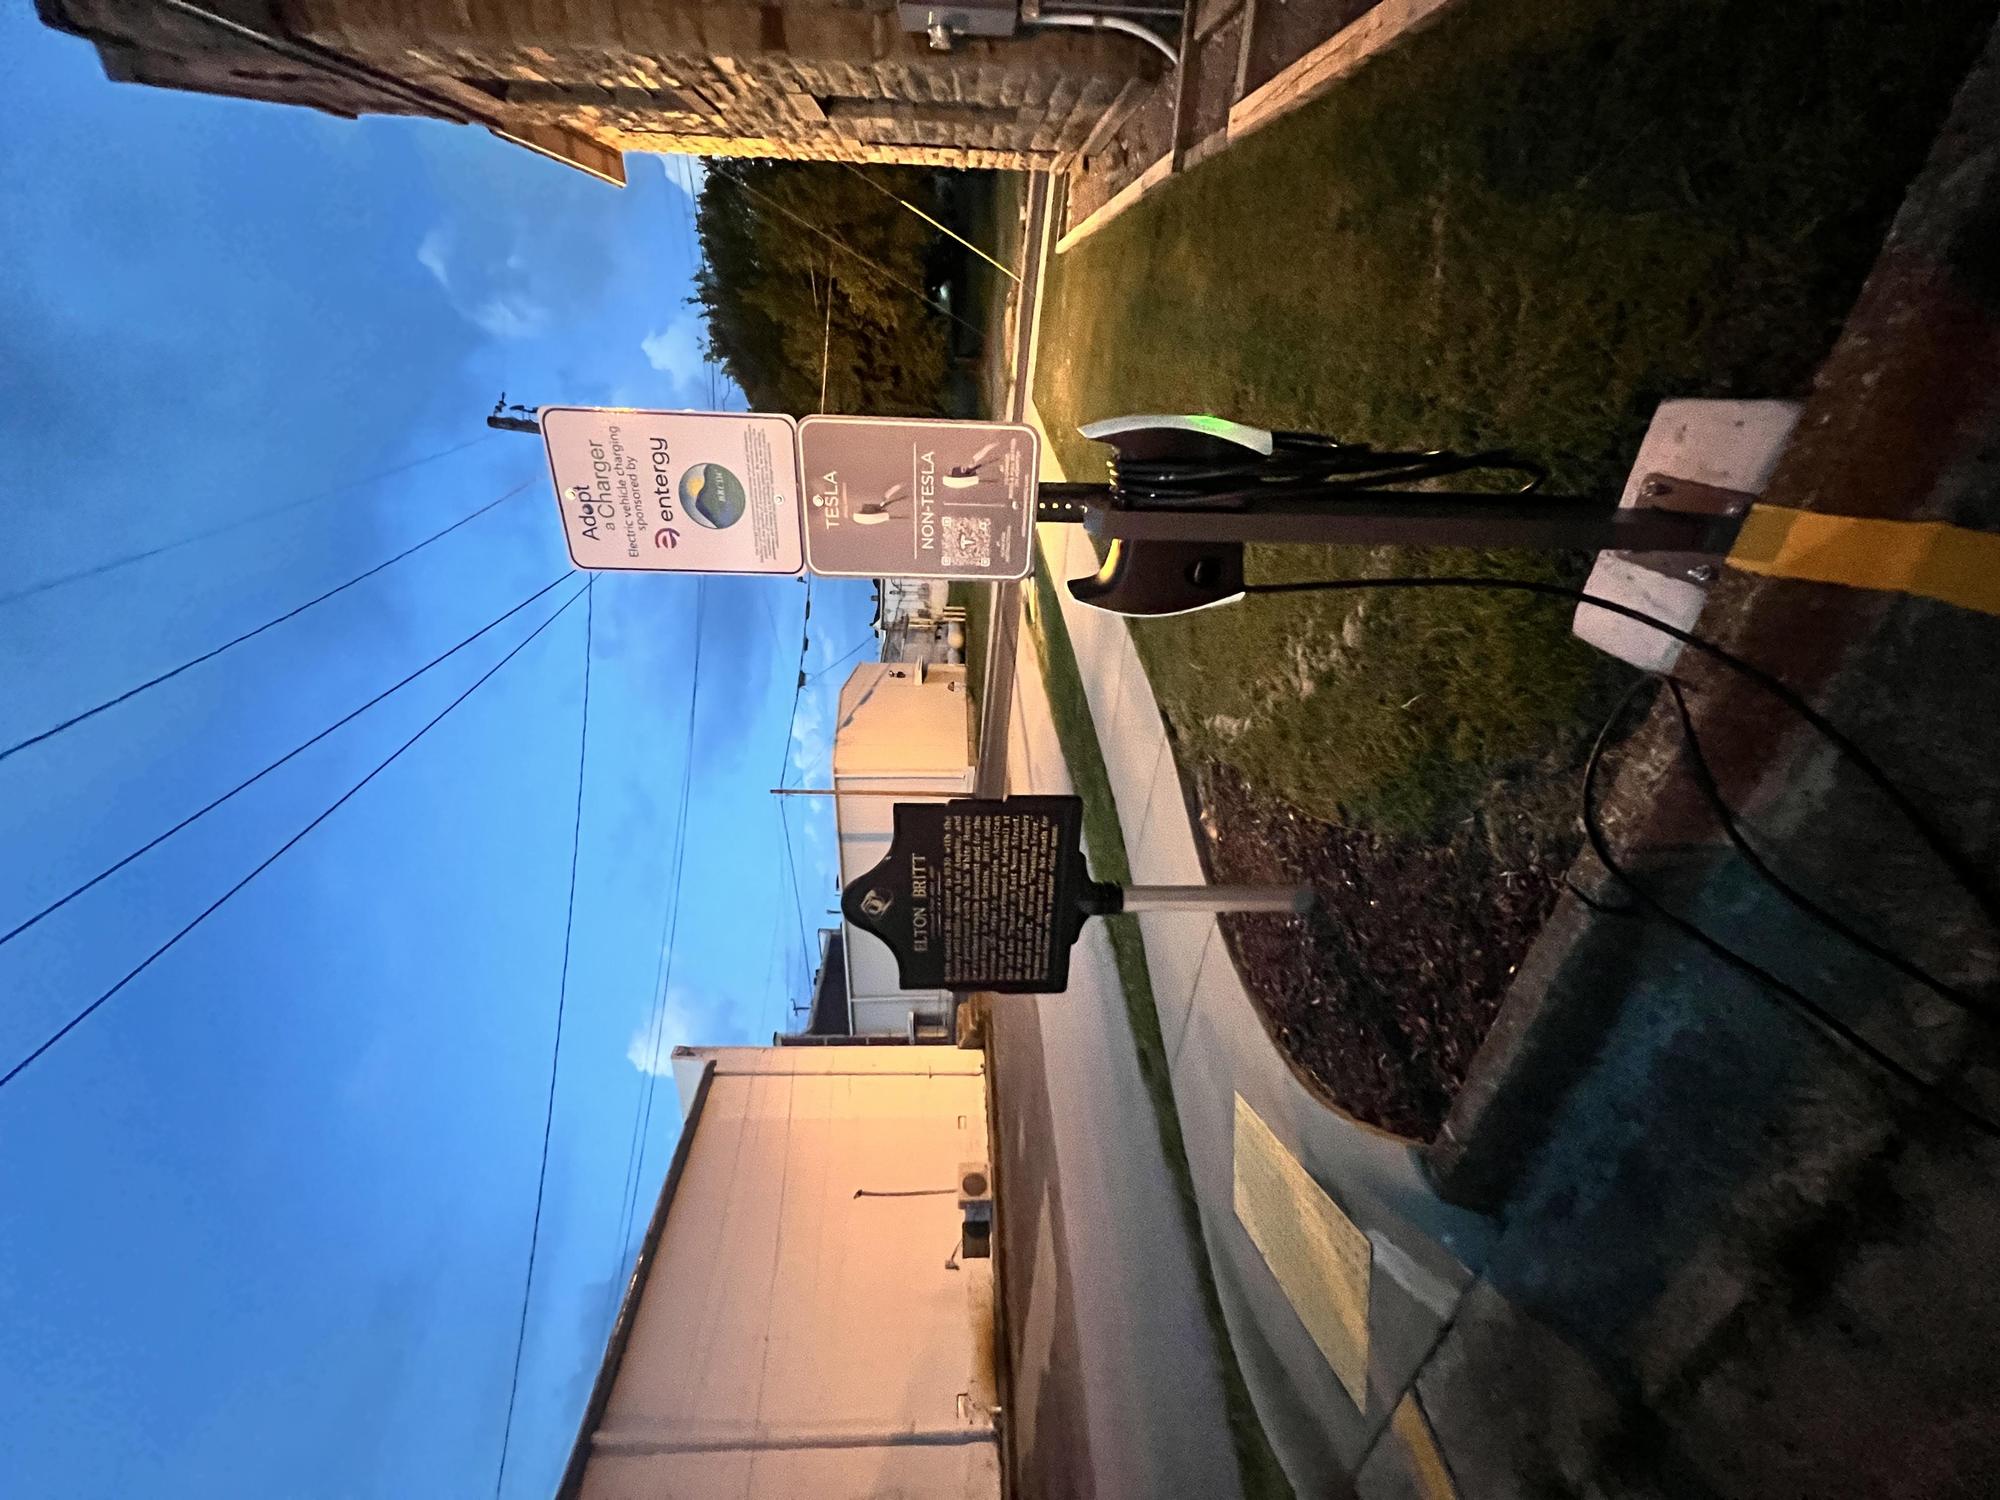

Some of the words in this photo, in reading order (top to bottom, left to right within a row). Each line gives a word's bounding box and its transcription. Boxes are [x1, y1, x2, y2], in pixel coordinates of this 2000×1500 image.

[608, 425, 625, 476] charging
[625, 455, 638, 470] by
[588, 439, 615, 518] Charger
[617, 479, 632, 518] vehicle
[649, 437, 674, 522] entergy
[823, 470, 840, 530] TESLA
[921, 451, 935, 550] NON-TESLA
[573, 484, 600, 541] Adopt
[628, 473, 648, 531] sponsored
[604, 522, 616, 531] a
[624, 520, 640, 557] Electric
[1039, 831, 1047, 853] death
[912, 853, 926, 897] BRITT
[1000, 878, 1008, 918] performed
[912, 907, 928, 952] ELTON
